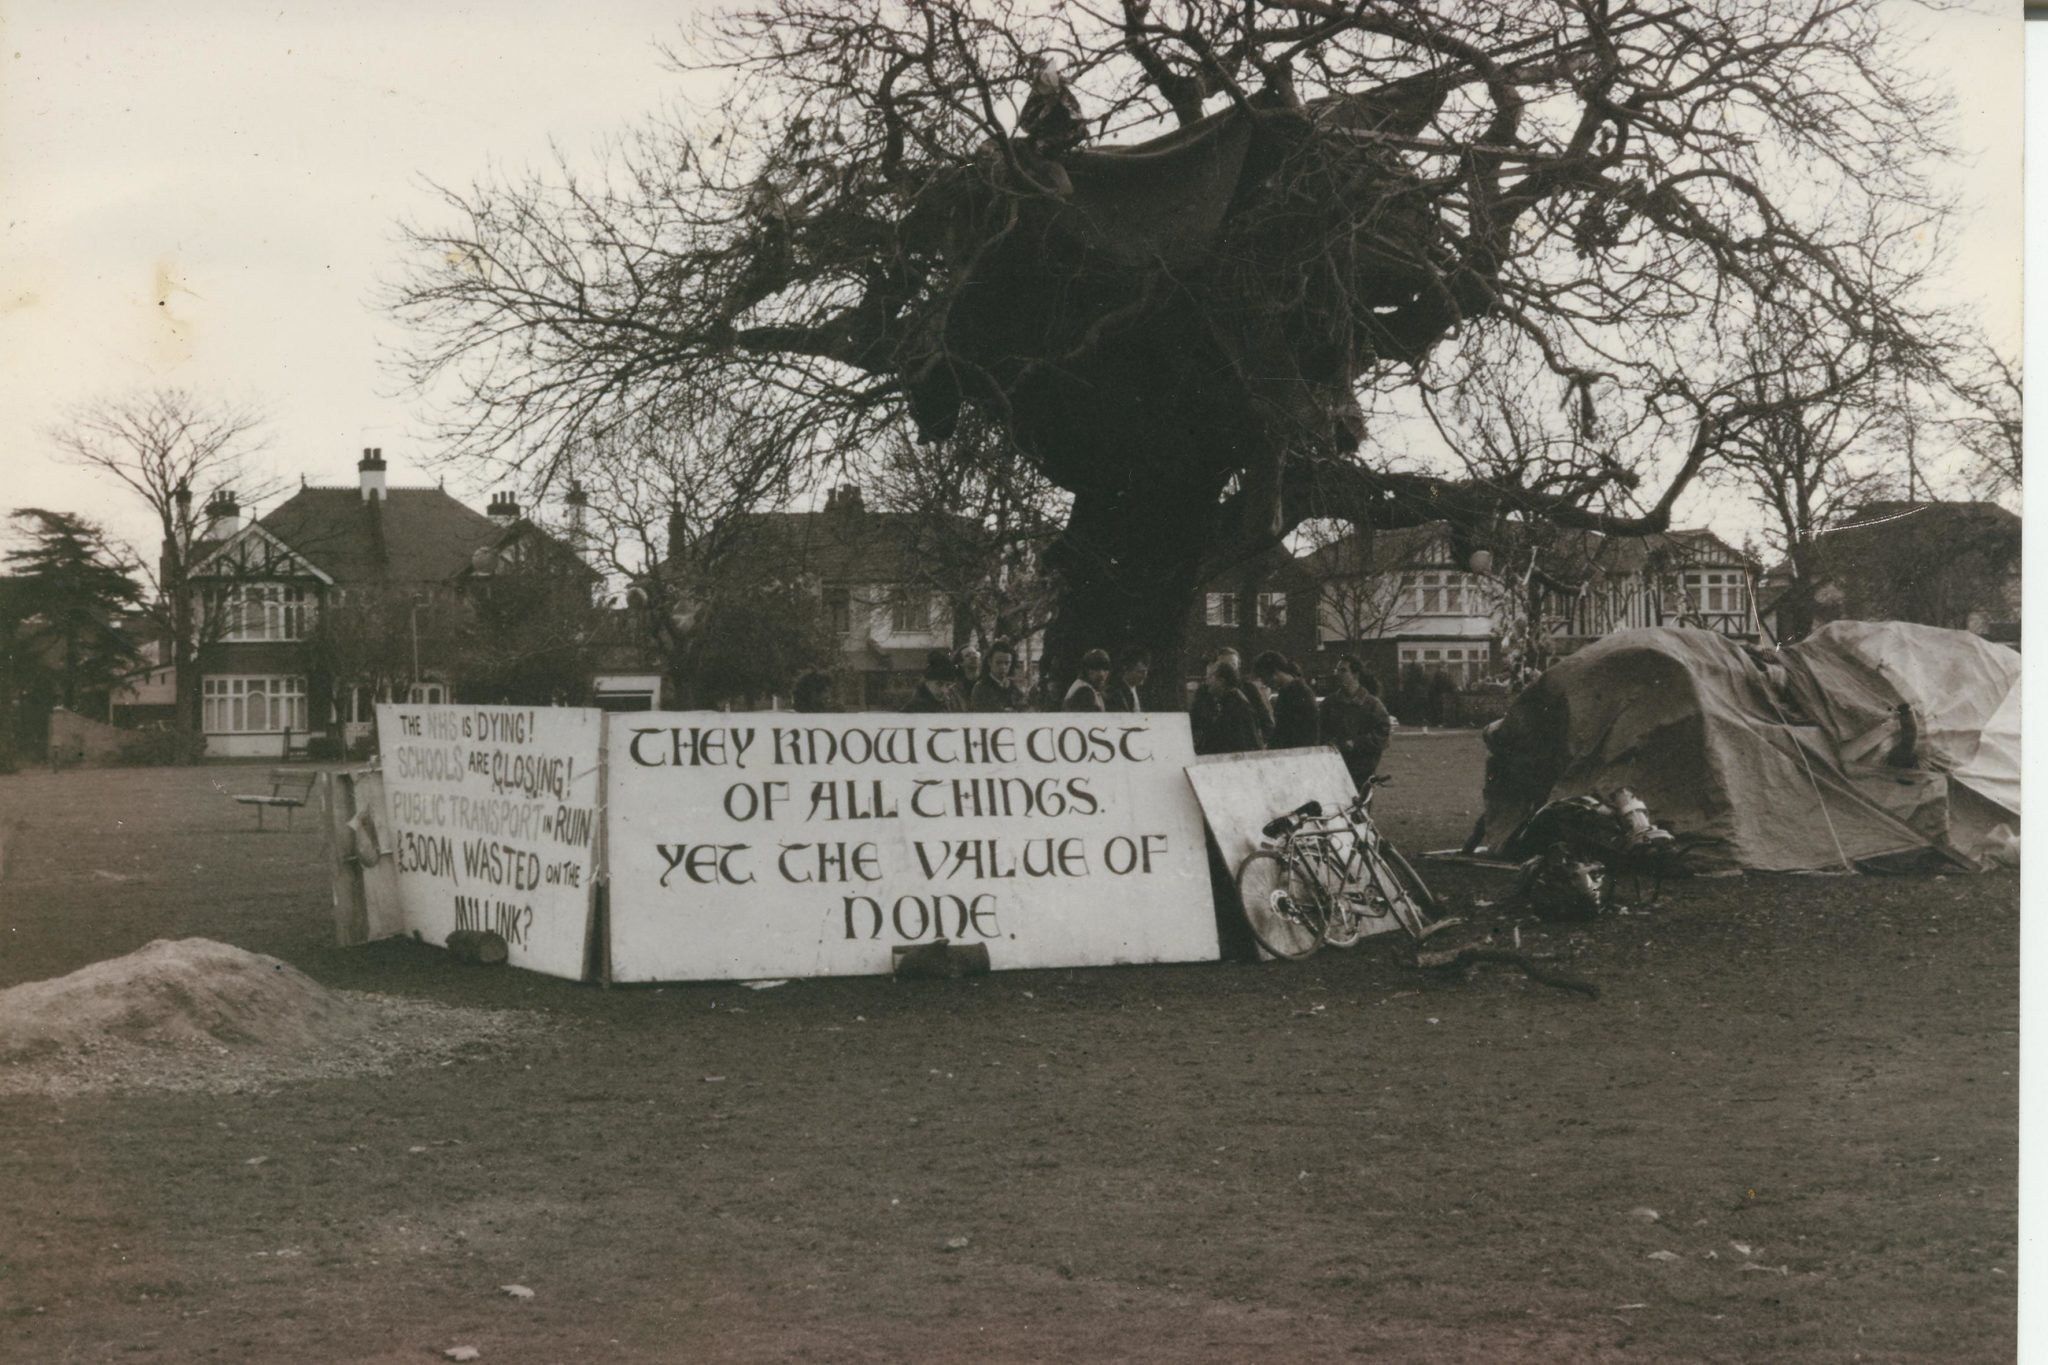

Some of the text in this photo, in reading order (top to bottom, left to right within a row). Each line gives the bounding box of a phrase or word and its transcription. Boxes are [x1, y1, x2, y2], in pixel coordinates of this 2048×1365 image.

[400, 711, 534, 744] THE NHS IS DYING!
[629, 726, 1154, 769] THEY KNOW THE COST
[398, 746, 573, 800] SCHOOLS ARE CLOSING!
[393, 791, 592, 848] PUBLIC TRANSPORT IN RUIN
[723, 776, 1105, 822] OF ALL THINGS.
[464, 838, 540, 891] WASTED
[546, 863, 561, 885] ON
[563, 861, 580, 888] THE
[656, 834, 1168, 887] YET THE VALUE OF
[843, 893, 1016, 941] NONE.
